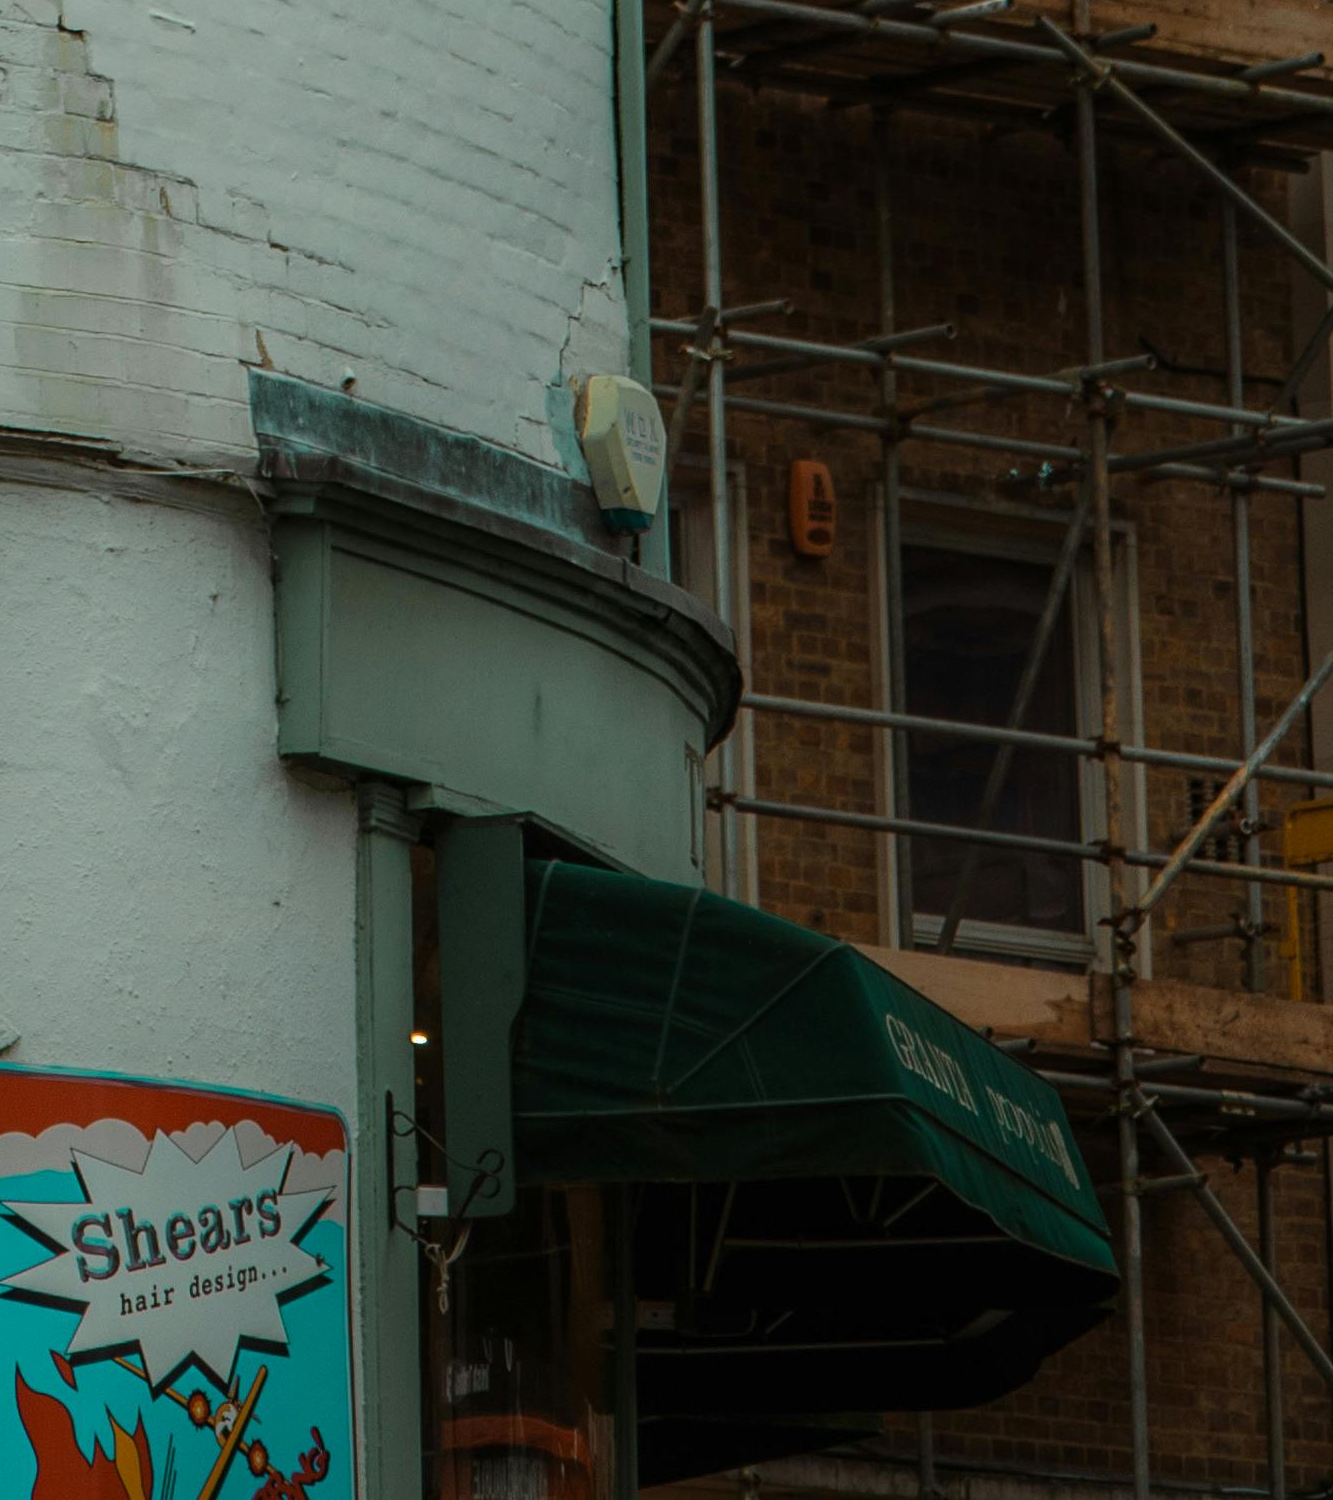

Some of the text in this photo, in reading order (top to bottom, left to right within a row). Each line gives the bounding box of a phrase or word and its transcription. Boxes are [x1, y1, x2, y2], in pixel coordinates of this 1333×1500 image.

[885, 1013, 979, 1117] GRANTA
[71, 1187, 283, 1283] Shears
[119, 1264, 288, 1316] hair design...
